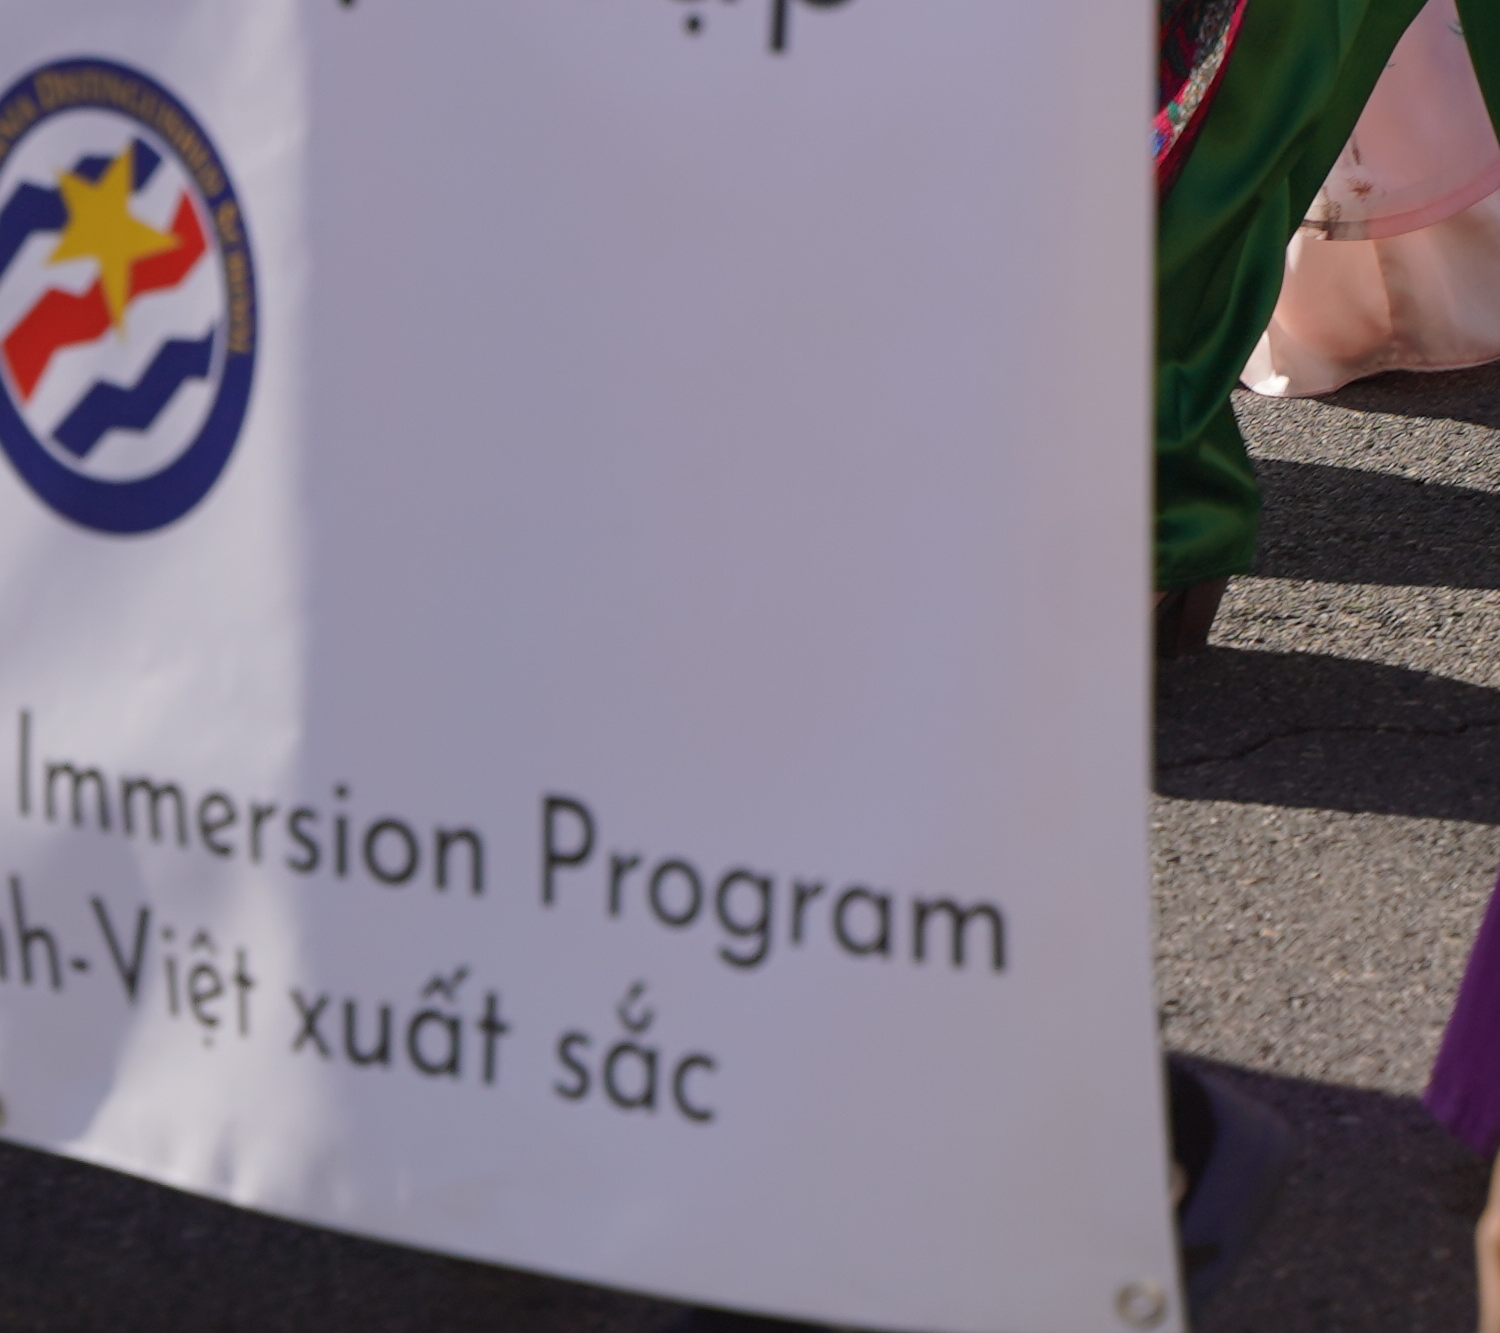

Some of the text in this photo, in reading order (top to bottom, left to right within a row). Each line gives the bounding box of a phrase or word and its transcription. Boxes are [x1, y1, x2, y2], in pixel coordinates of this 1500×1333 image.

[18, 707, 487, 897] Immersion
[539, 793, 1010, 975] Program
[288, 966, 513, 1089] xuất
[552, 979, 722, 1126] sắc
